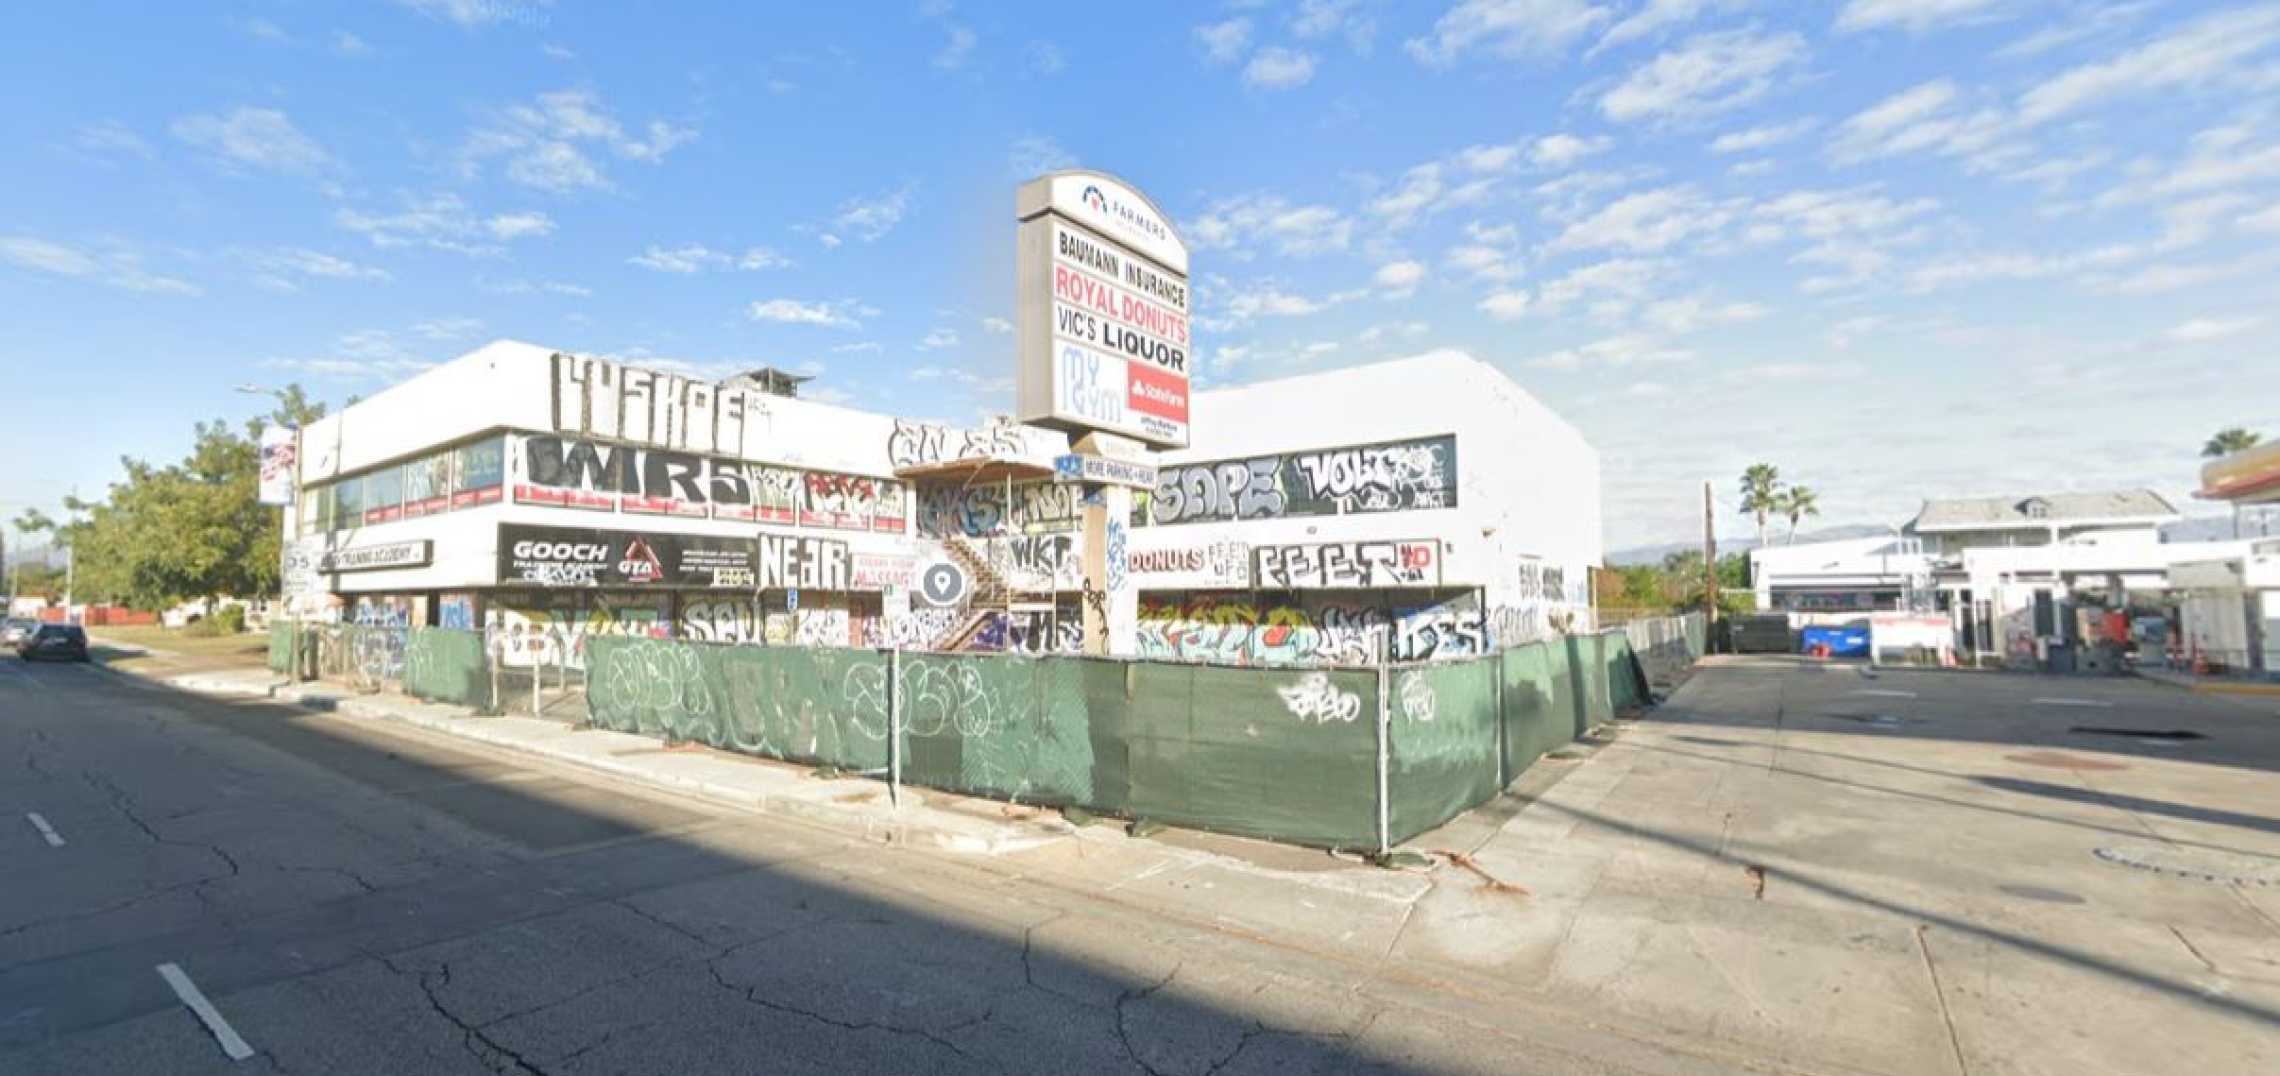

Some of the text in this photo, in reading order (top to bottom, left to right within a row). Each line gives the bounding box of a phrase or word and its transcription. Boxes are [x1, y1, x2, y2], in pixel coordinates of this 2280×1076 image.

[1113, 200, 1166, 241] FARMERS
[1059, 231, 1185, 307] BAUMANN INSURANCE
[1055, 266, 1186, 344] ROYAL DONUTS
[1058, 306, 1185, 372] VIC'S LIQUOR
[513, 540, 609, 561] GOOCH
[1127, 548, 1205, 573] DONUTS
